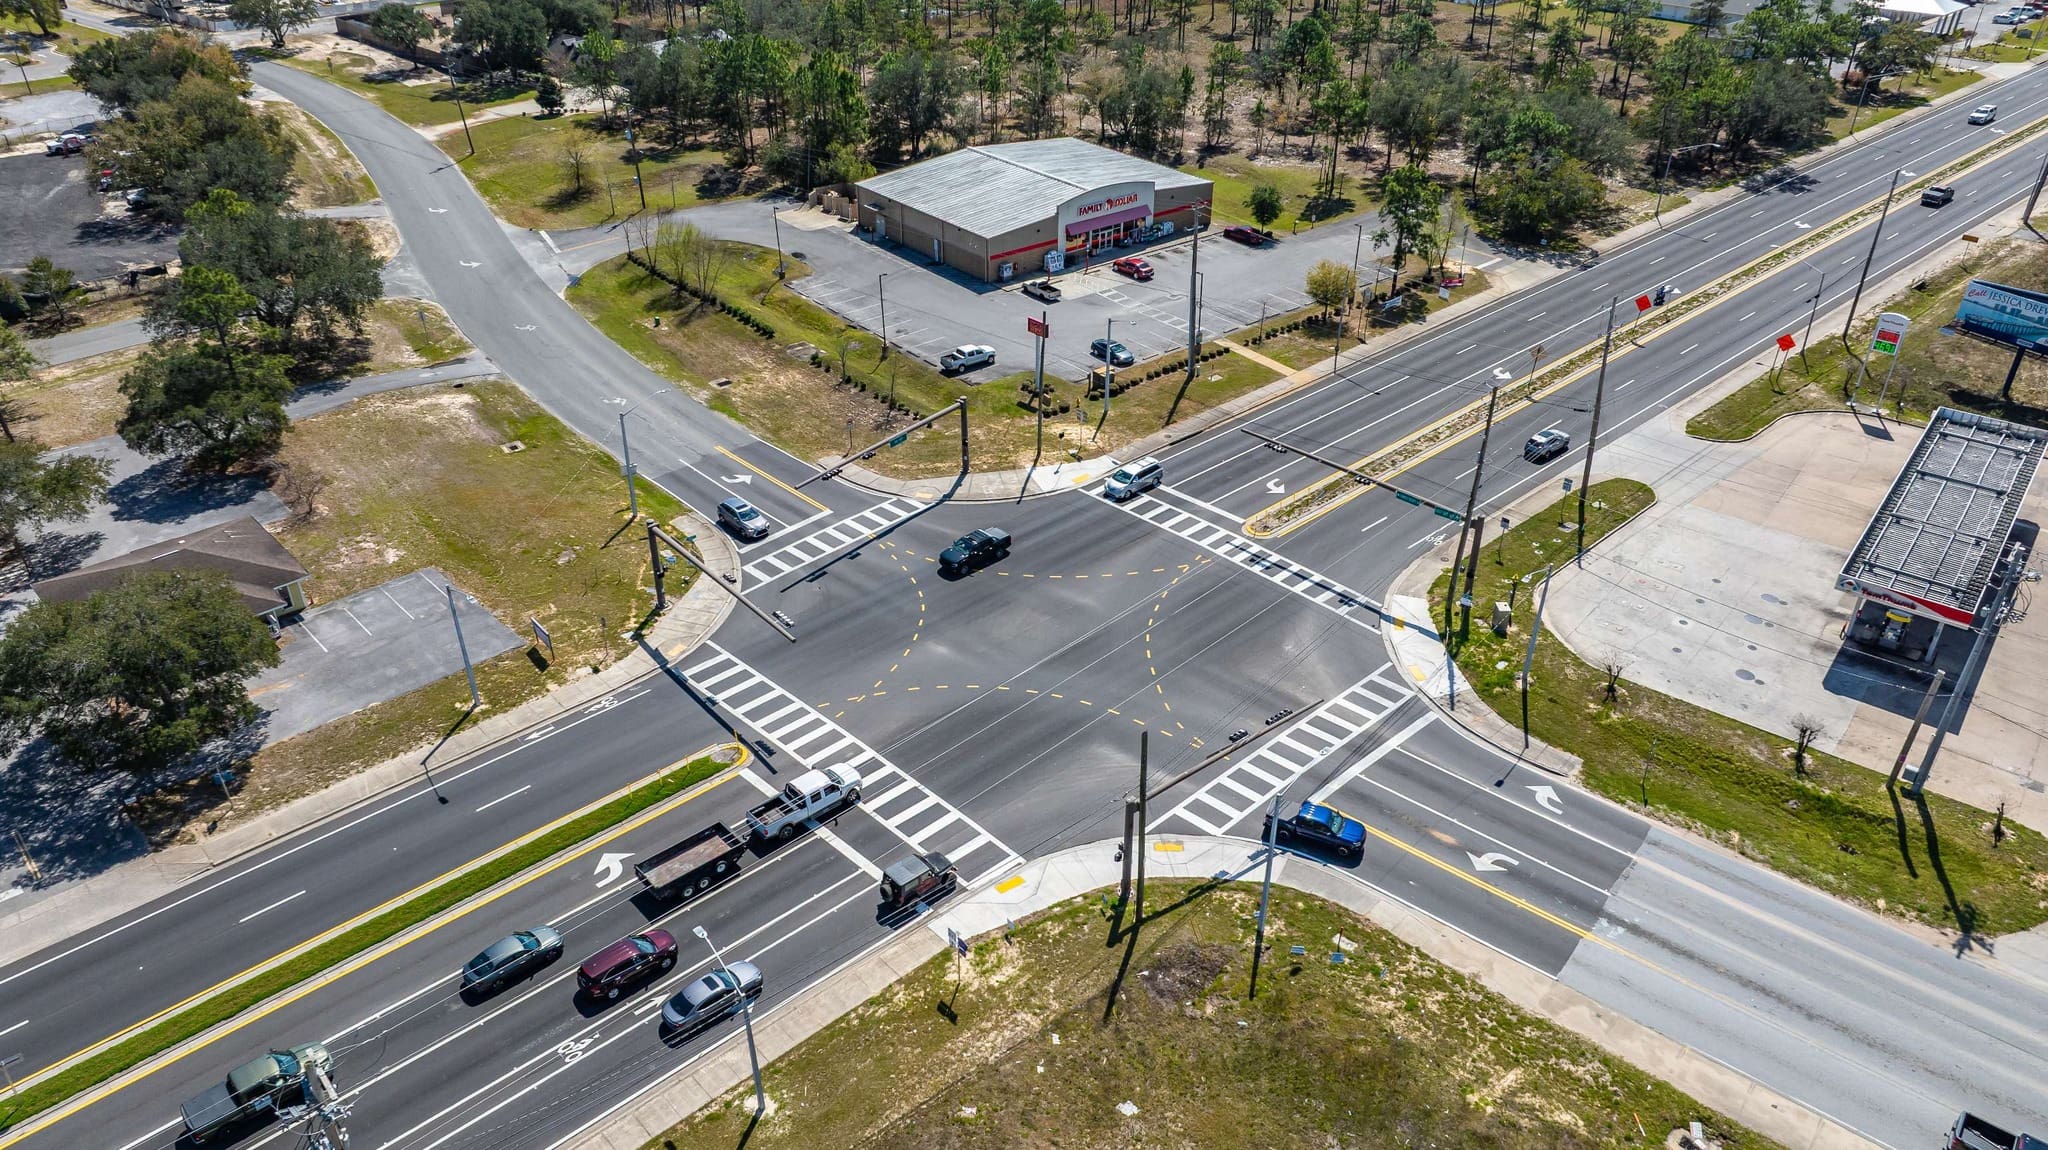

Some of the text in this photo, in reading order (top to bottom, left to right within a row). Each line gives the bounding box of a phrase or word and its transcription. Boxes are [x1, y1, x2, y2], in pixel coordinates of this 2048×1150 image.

[1079, 194, 1138, 216] FAMILY DOLLAR
[1968, 288, 1988, 297] Call
[1989, 290, 2021, 307] JESSICA
